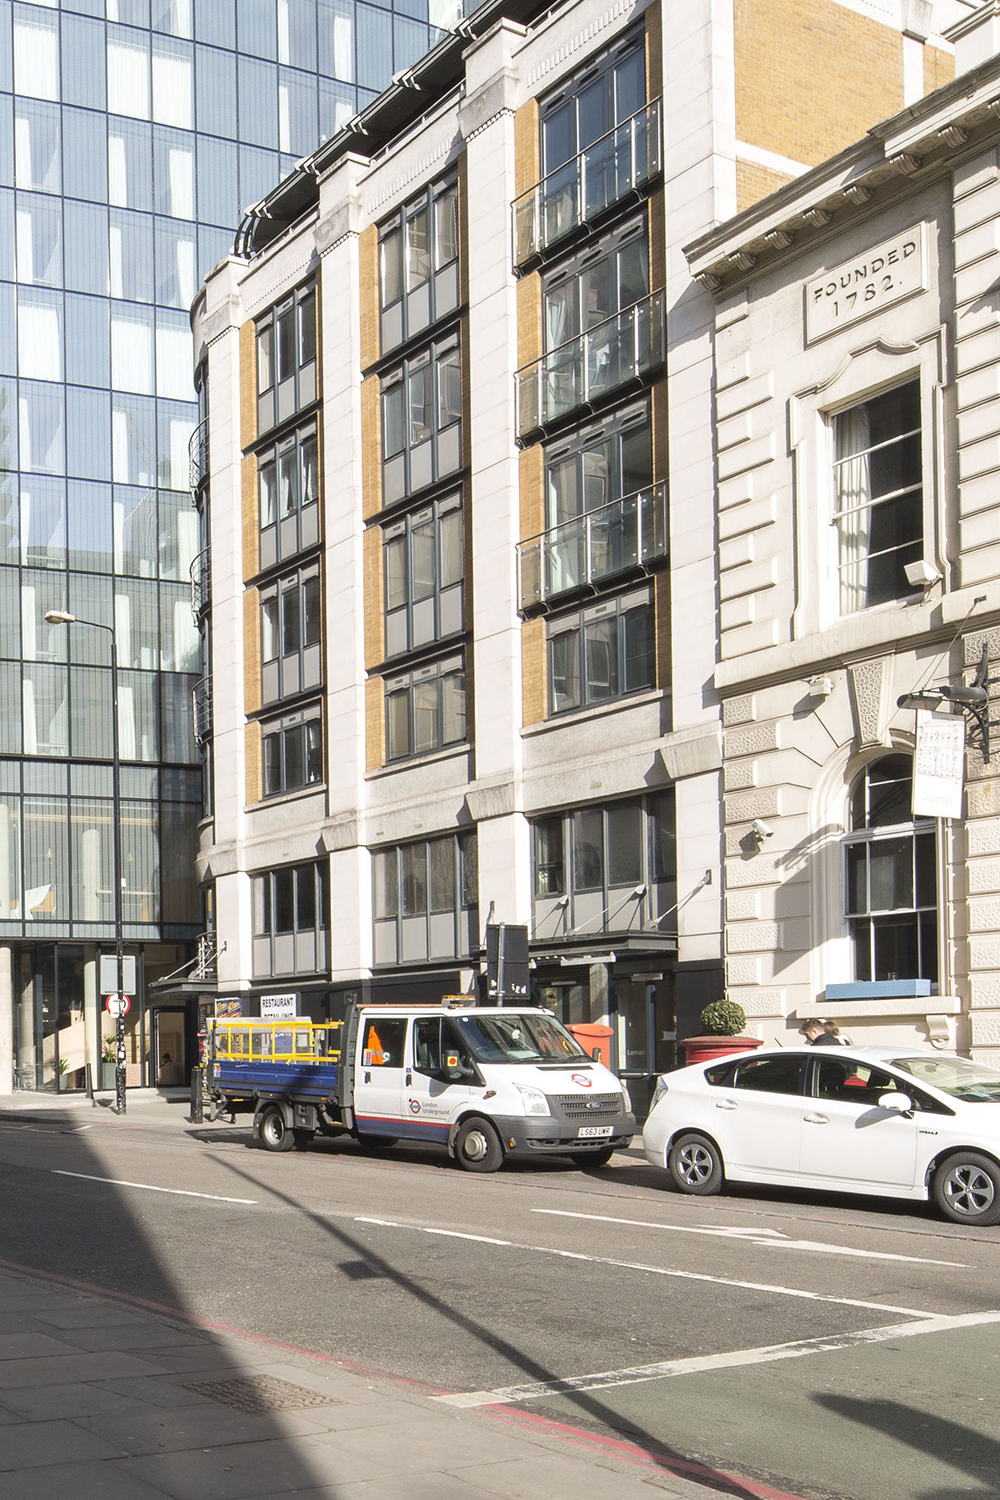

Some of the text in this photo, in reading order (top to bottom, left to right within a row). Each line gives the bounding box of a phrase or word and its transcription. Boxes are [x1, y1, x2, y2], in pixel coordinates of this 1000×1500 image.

[814, 241, 916, 304] FOUNDED
[833, 274, 903, 317] 1782.
[262, 998, 293, 1008] RESTAURANT
[422, 1108, 450, 1116] Underground
[580, 1127, 597, 1136] LS63
